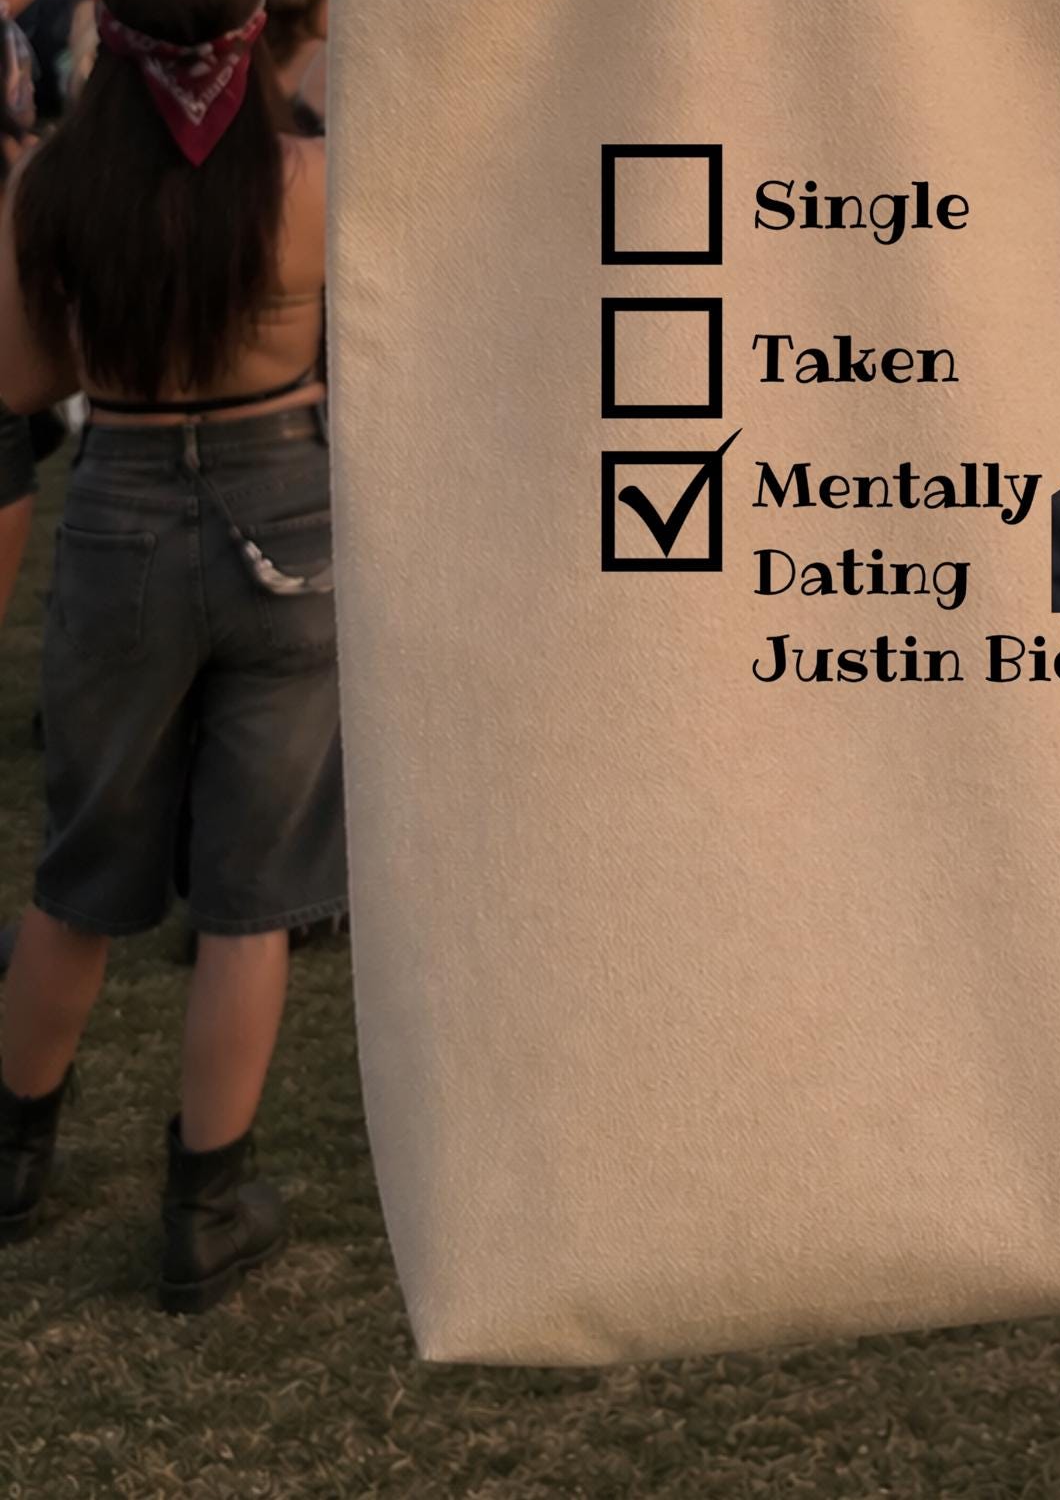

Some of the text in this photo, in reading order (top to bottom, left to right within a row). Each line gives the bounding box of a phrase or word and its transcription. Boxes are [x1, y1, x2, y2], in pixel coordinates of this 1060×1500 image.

[753, 179, 970, 246] Single
[751, 333, 960, 385] Taken
[751, 460, 1043, 526] Mentally
[752, 548, 971, 611] Dating
[751, 634, 964, 684] Justin
